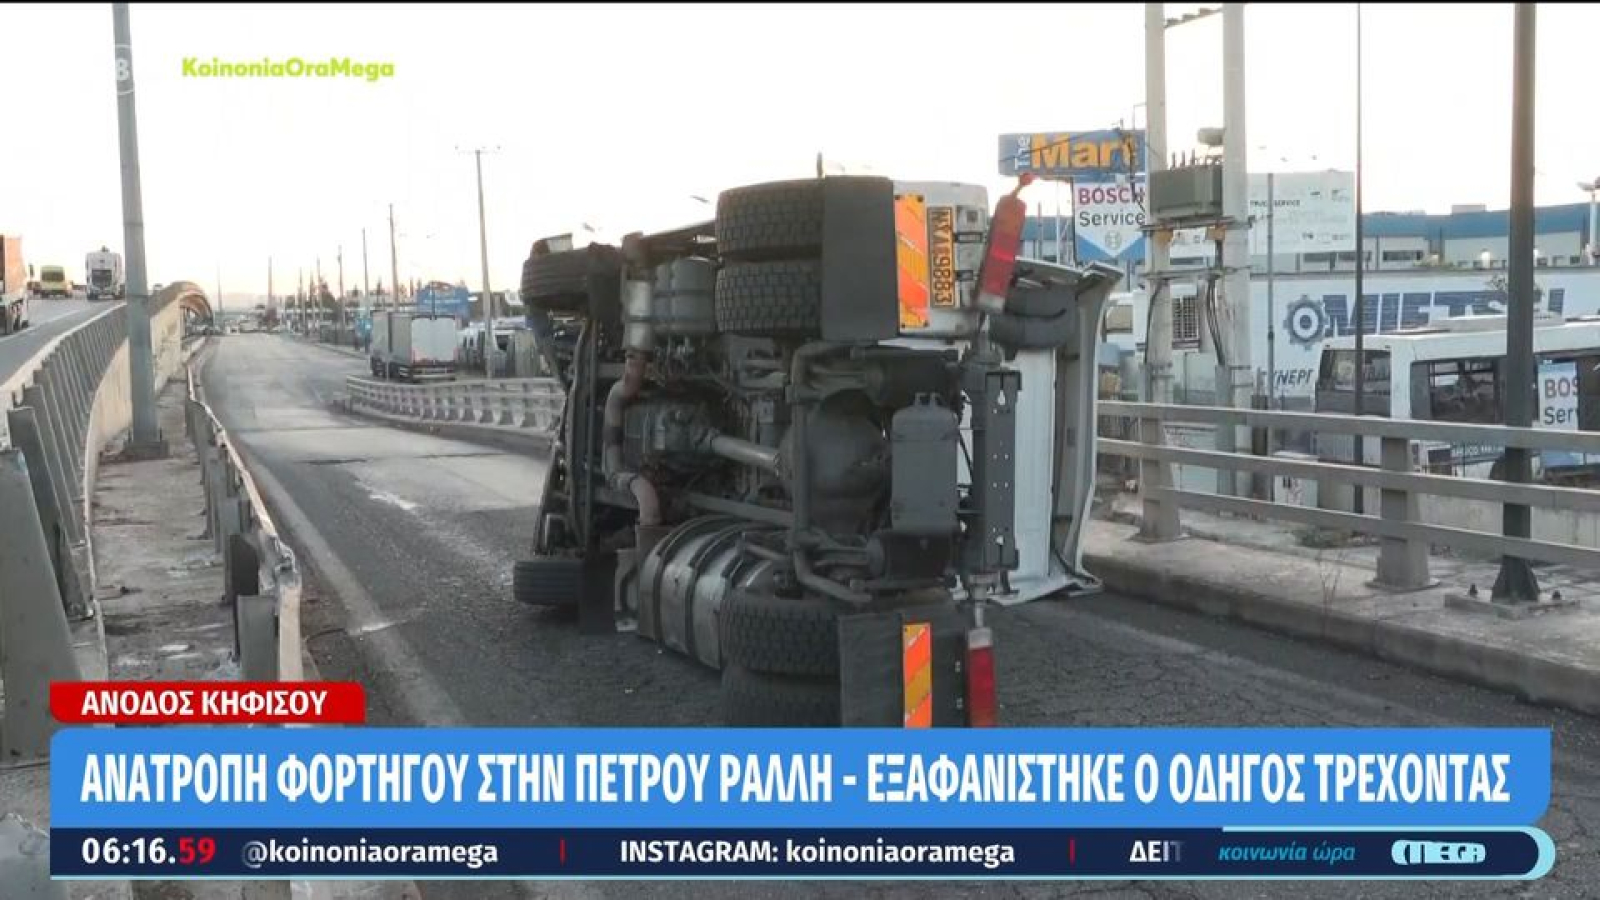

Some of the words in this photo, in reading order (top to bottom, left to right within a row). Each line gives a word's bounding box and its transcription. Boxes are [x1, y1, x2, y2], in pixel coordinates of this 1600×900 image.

[1031, 132, 1140, 169] Mart
[1077, 186, 1146, 205] BOSCH
[1079, 209, 1146, 227] Service
[1544, 406, 1578, 425] Ser
